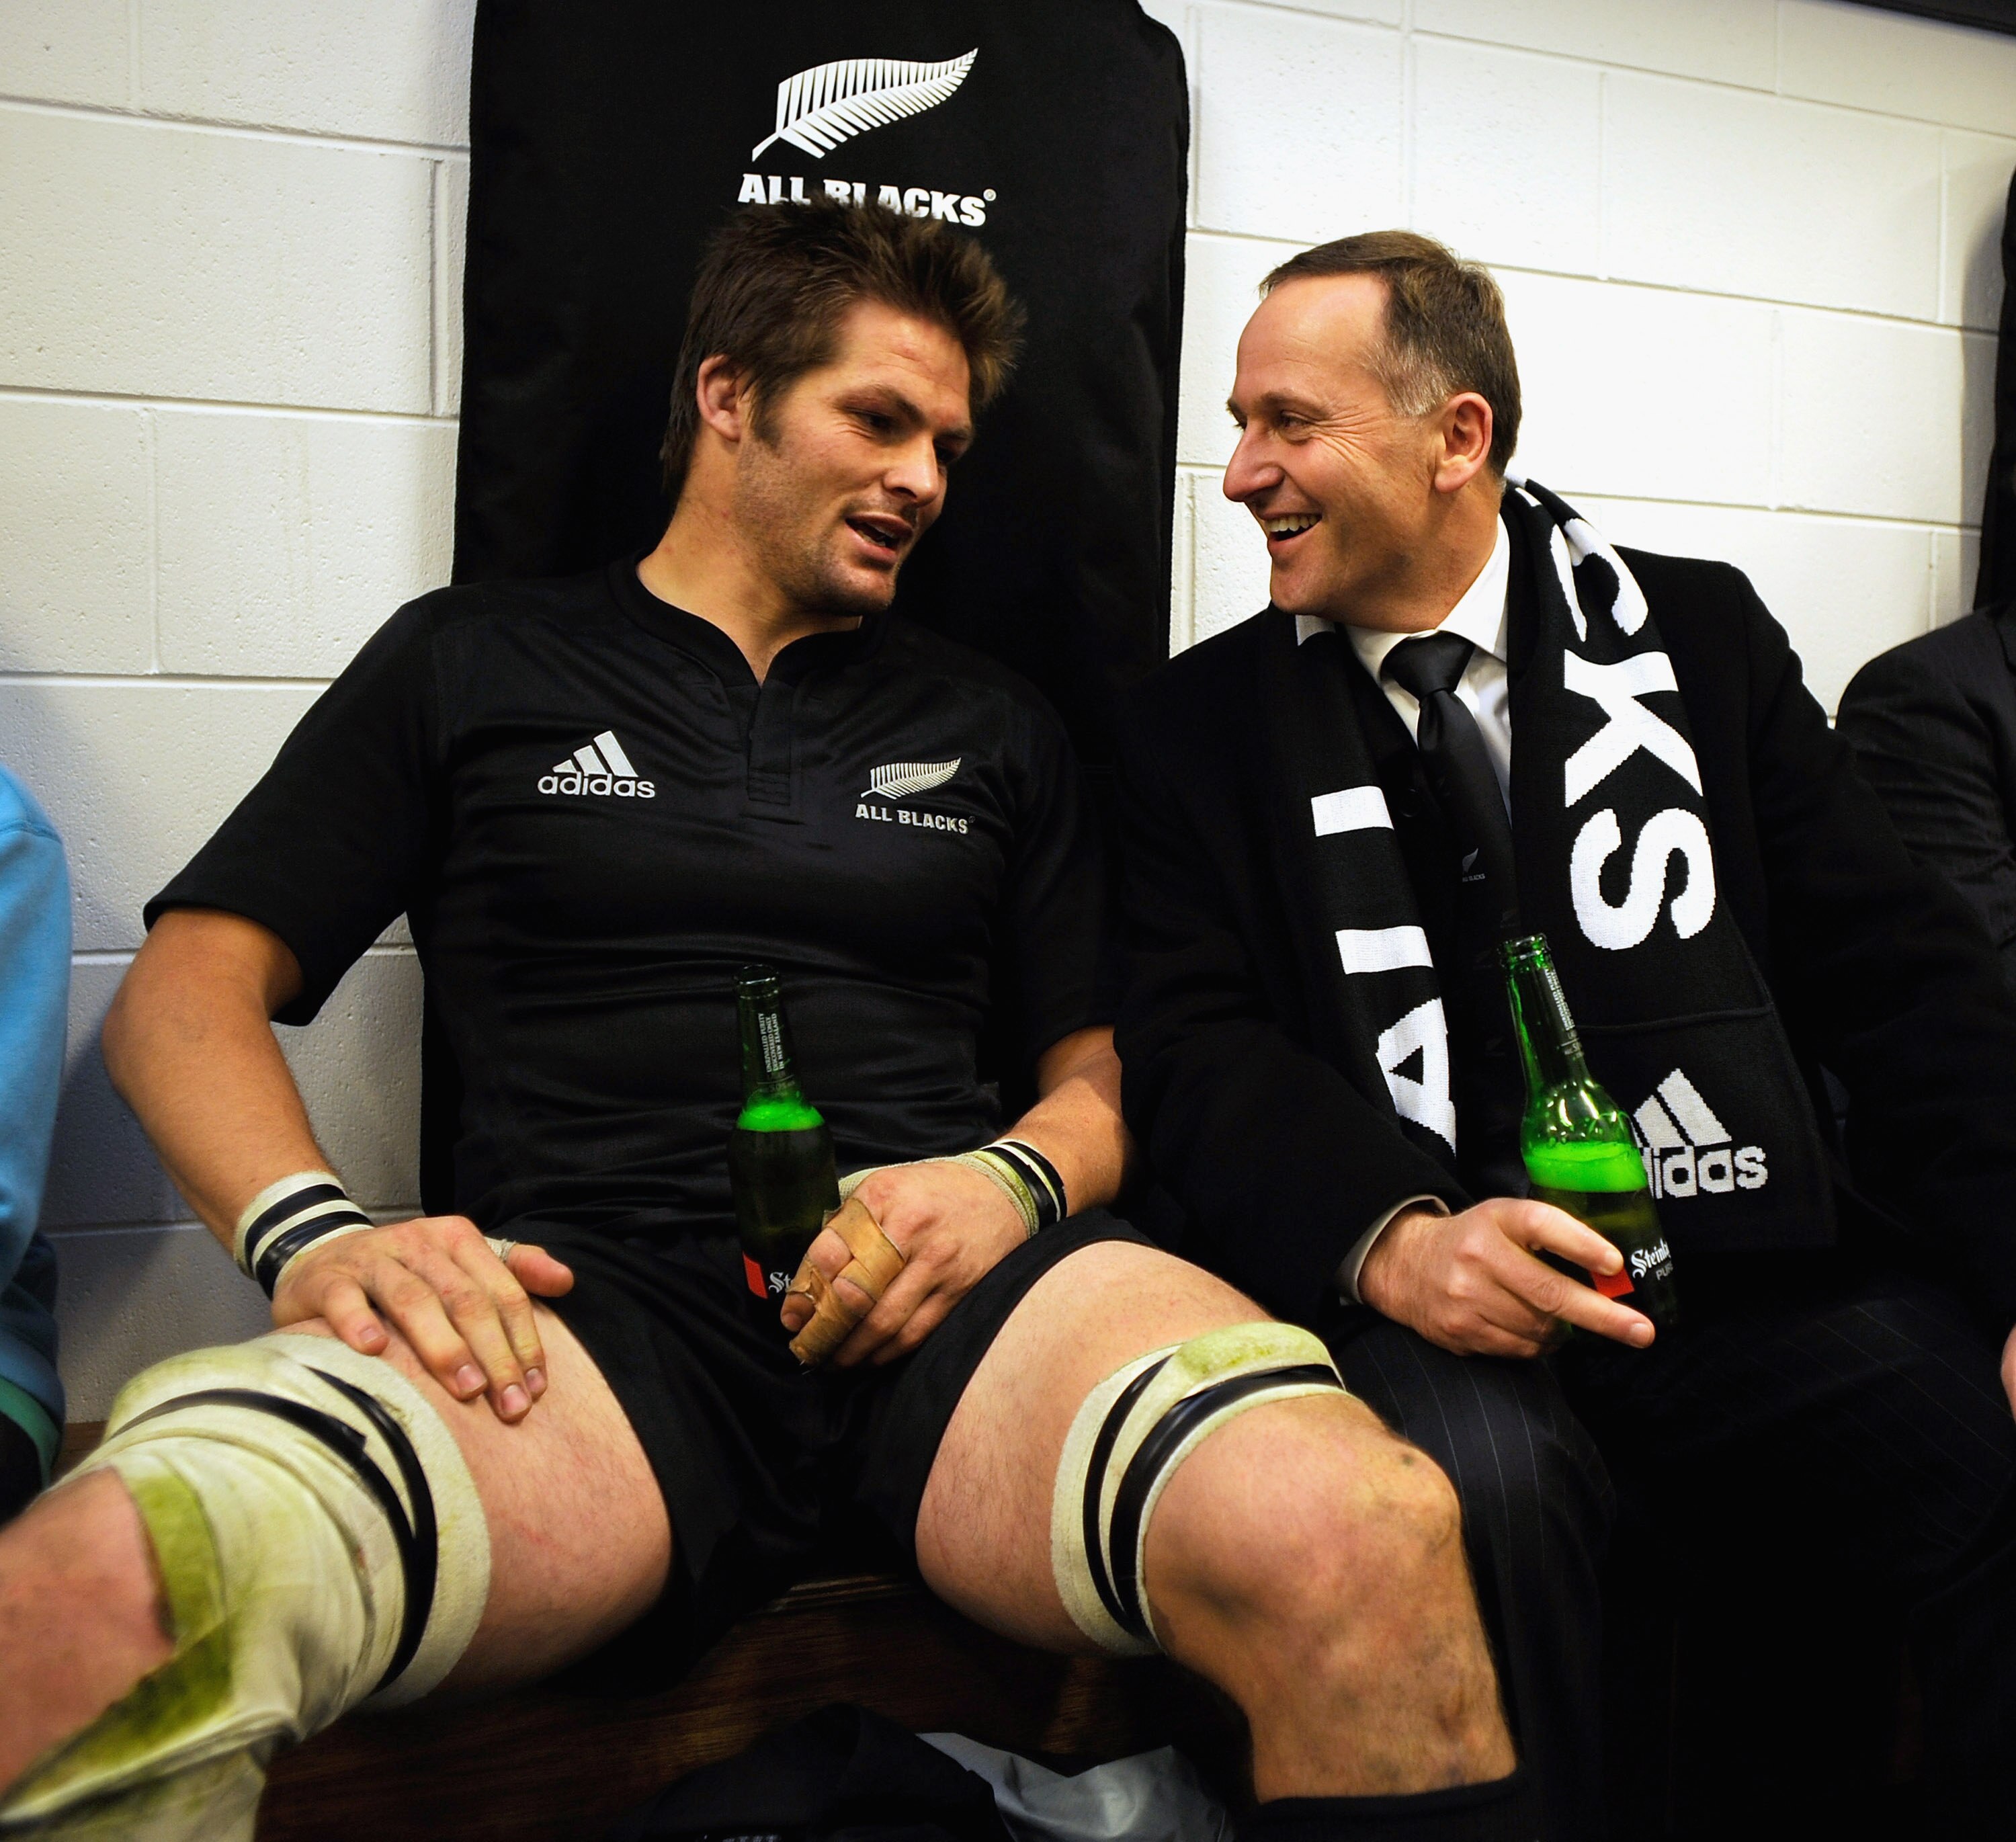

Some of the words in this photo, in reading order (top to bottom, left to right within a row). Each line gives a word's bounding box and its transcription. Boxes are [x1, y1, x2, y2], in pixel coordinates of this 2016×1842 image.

[738, 173, 810, 205] ALL
[823, 179, 986, 226] BLACKS
[1550, 517, 1717, 950] CKS
[537, 773, 656, 799] adidas
[855, 804, 892, 821] ALL
[896, 810, 968, 835] BLACKS
[758, 1013, 767, 1035] PURITY
[765, 1017, 773, 1034] ONLY
[771, 1013, 781, 1043] ZEALAND
[775, 1044, 784, 1060] NEW
[778, 1061, 784, 1070] IN
